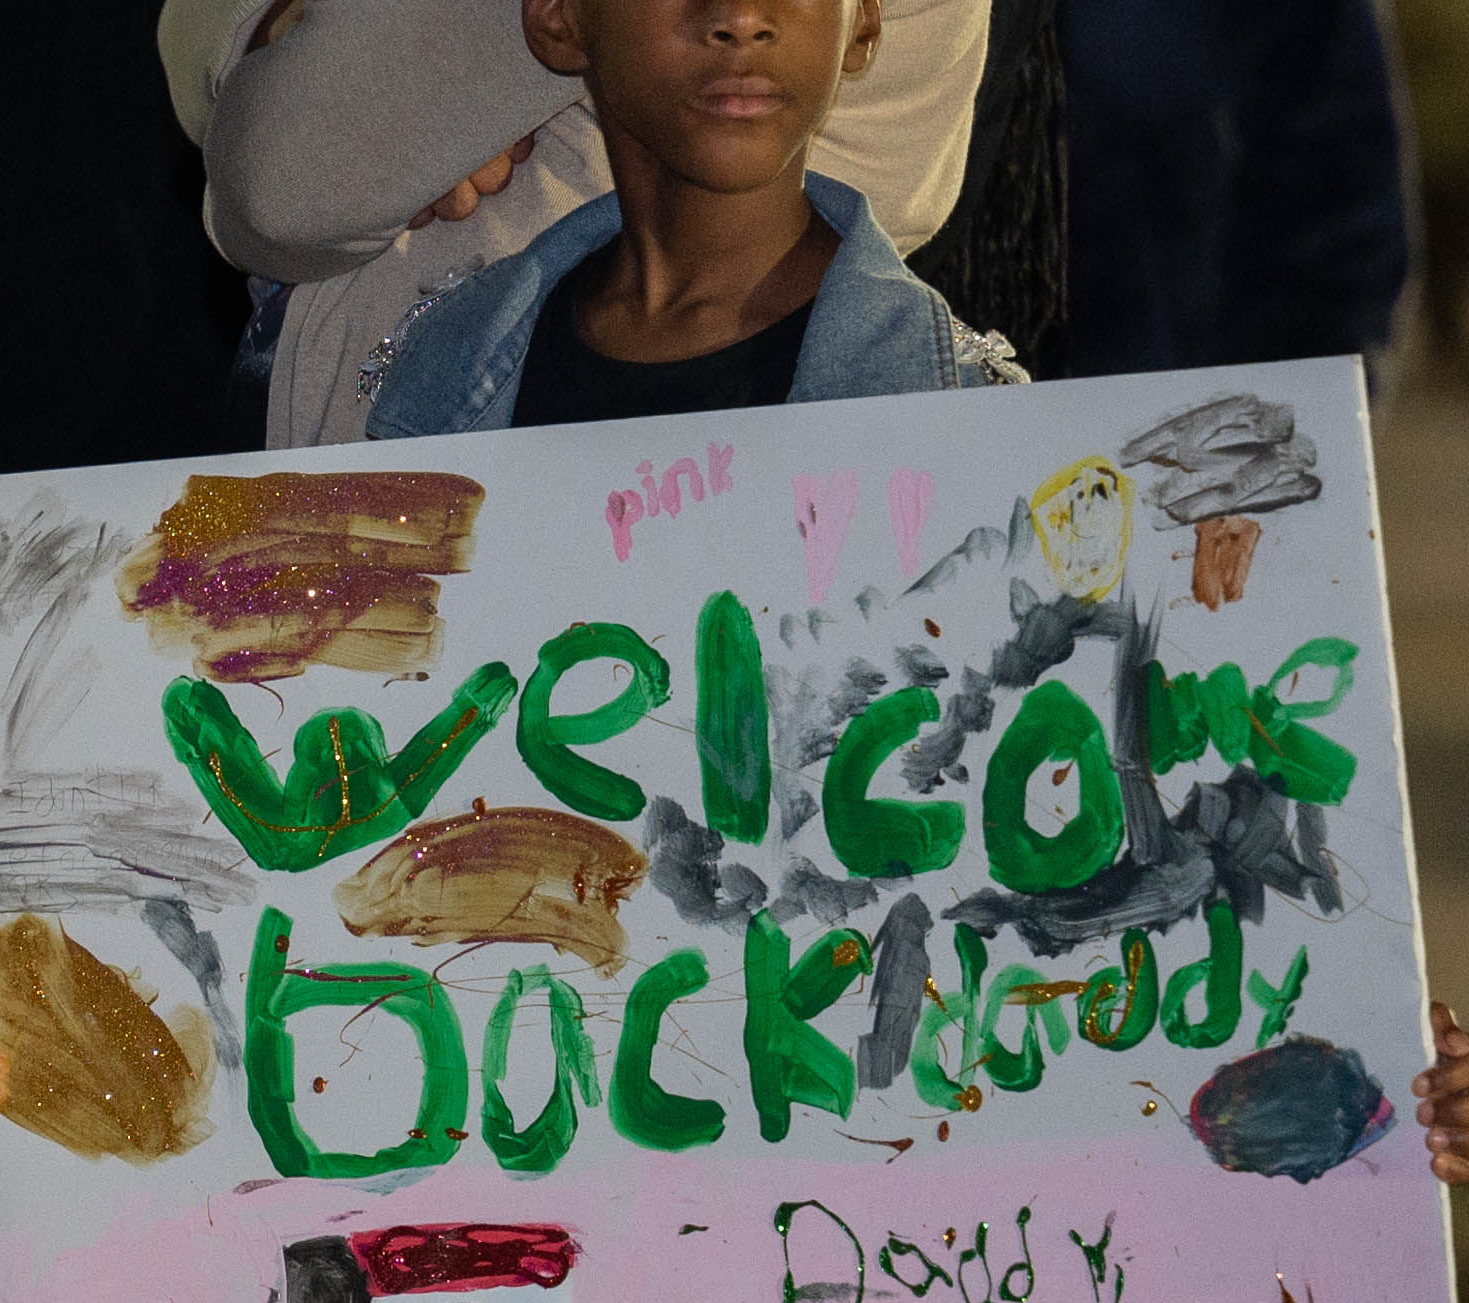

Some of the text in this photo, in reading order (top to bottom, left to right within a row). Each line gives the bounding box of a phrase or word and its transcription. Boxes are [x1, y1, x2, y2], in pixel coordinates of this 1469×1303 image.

[605, 442, 734, 563] pink
[162, 590, 1359, 894] welcome
[245, 898, 1309, 1179] back daddy
